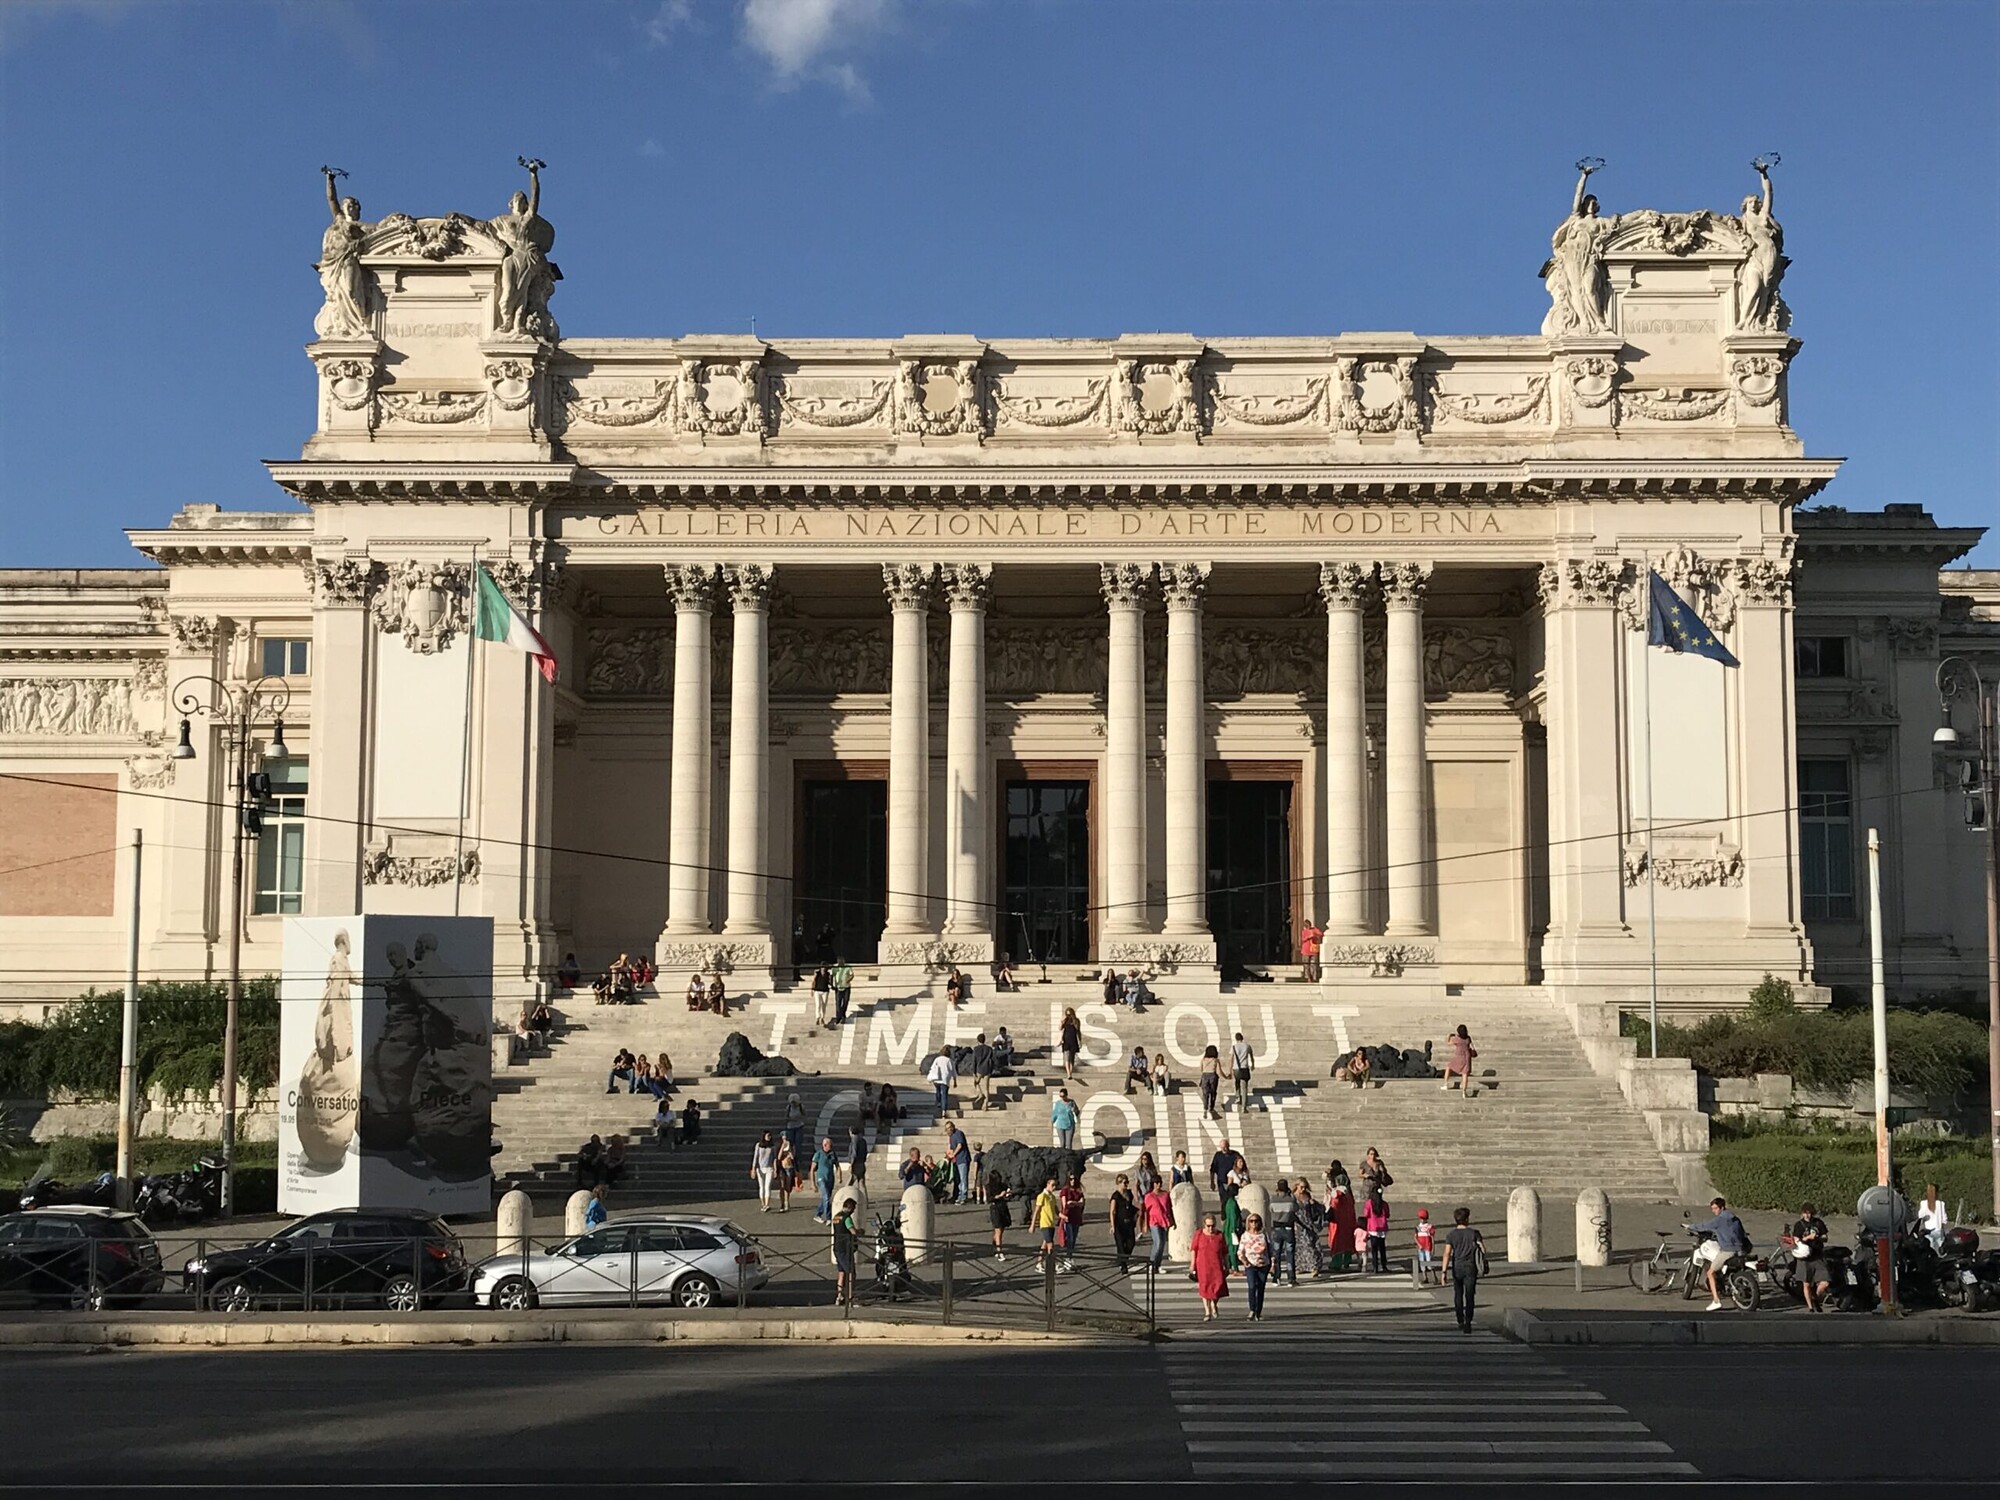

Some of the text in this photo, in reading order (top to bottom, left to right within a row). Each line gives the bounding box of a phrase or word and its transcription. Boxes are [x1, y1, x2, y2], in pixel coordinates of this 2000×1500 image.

[598, 512, 1502, 536] GALLERIA NAZIONALE D'ARTE MODERNA
[1050, 1002, 1123, 1067] IS
[288, 1090, 472, 1111] Conversation Piece
